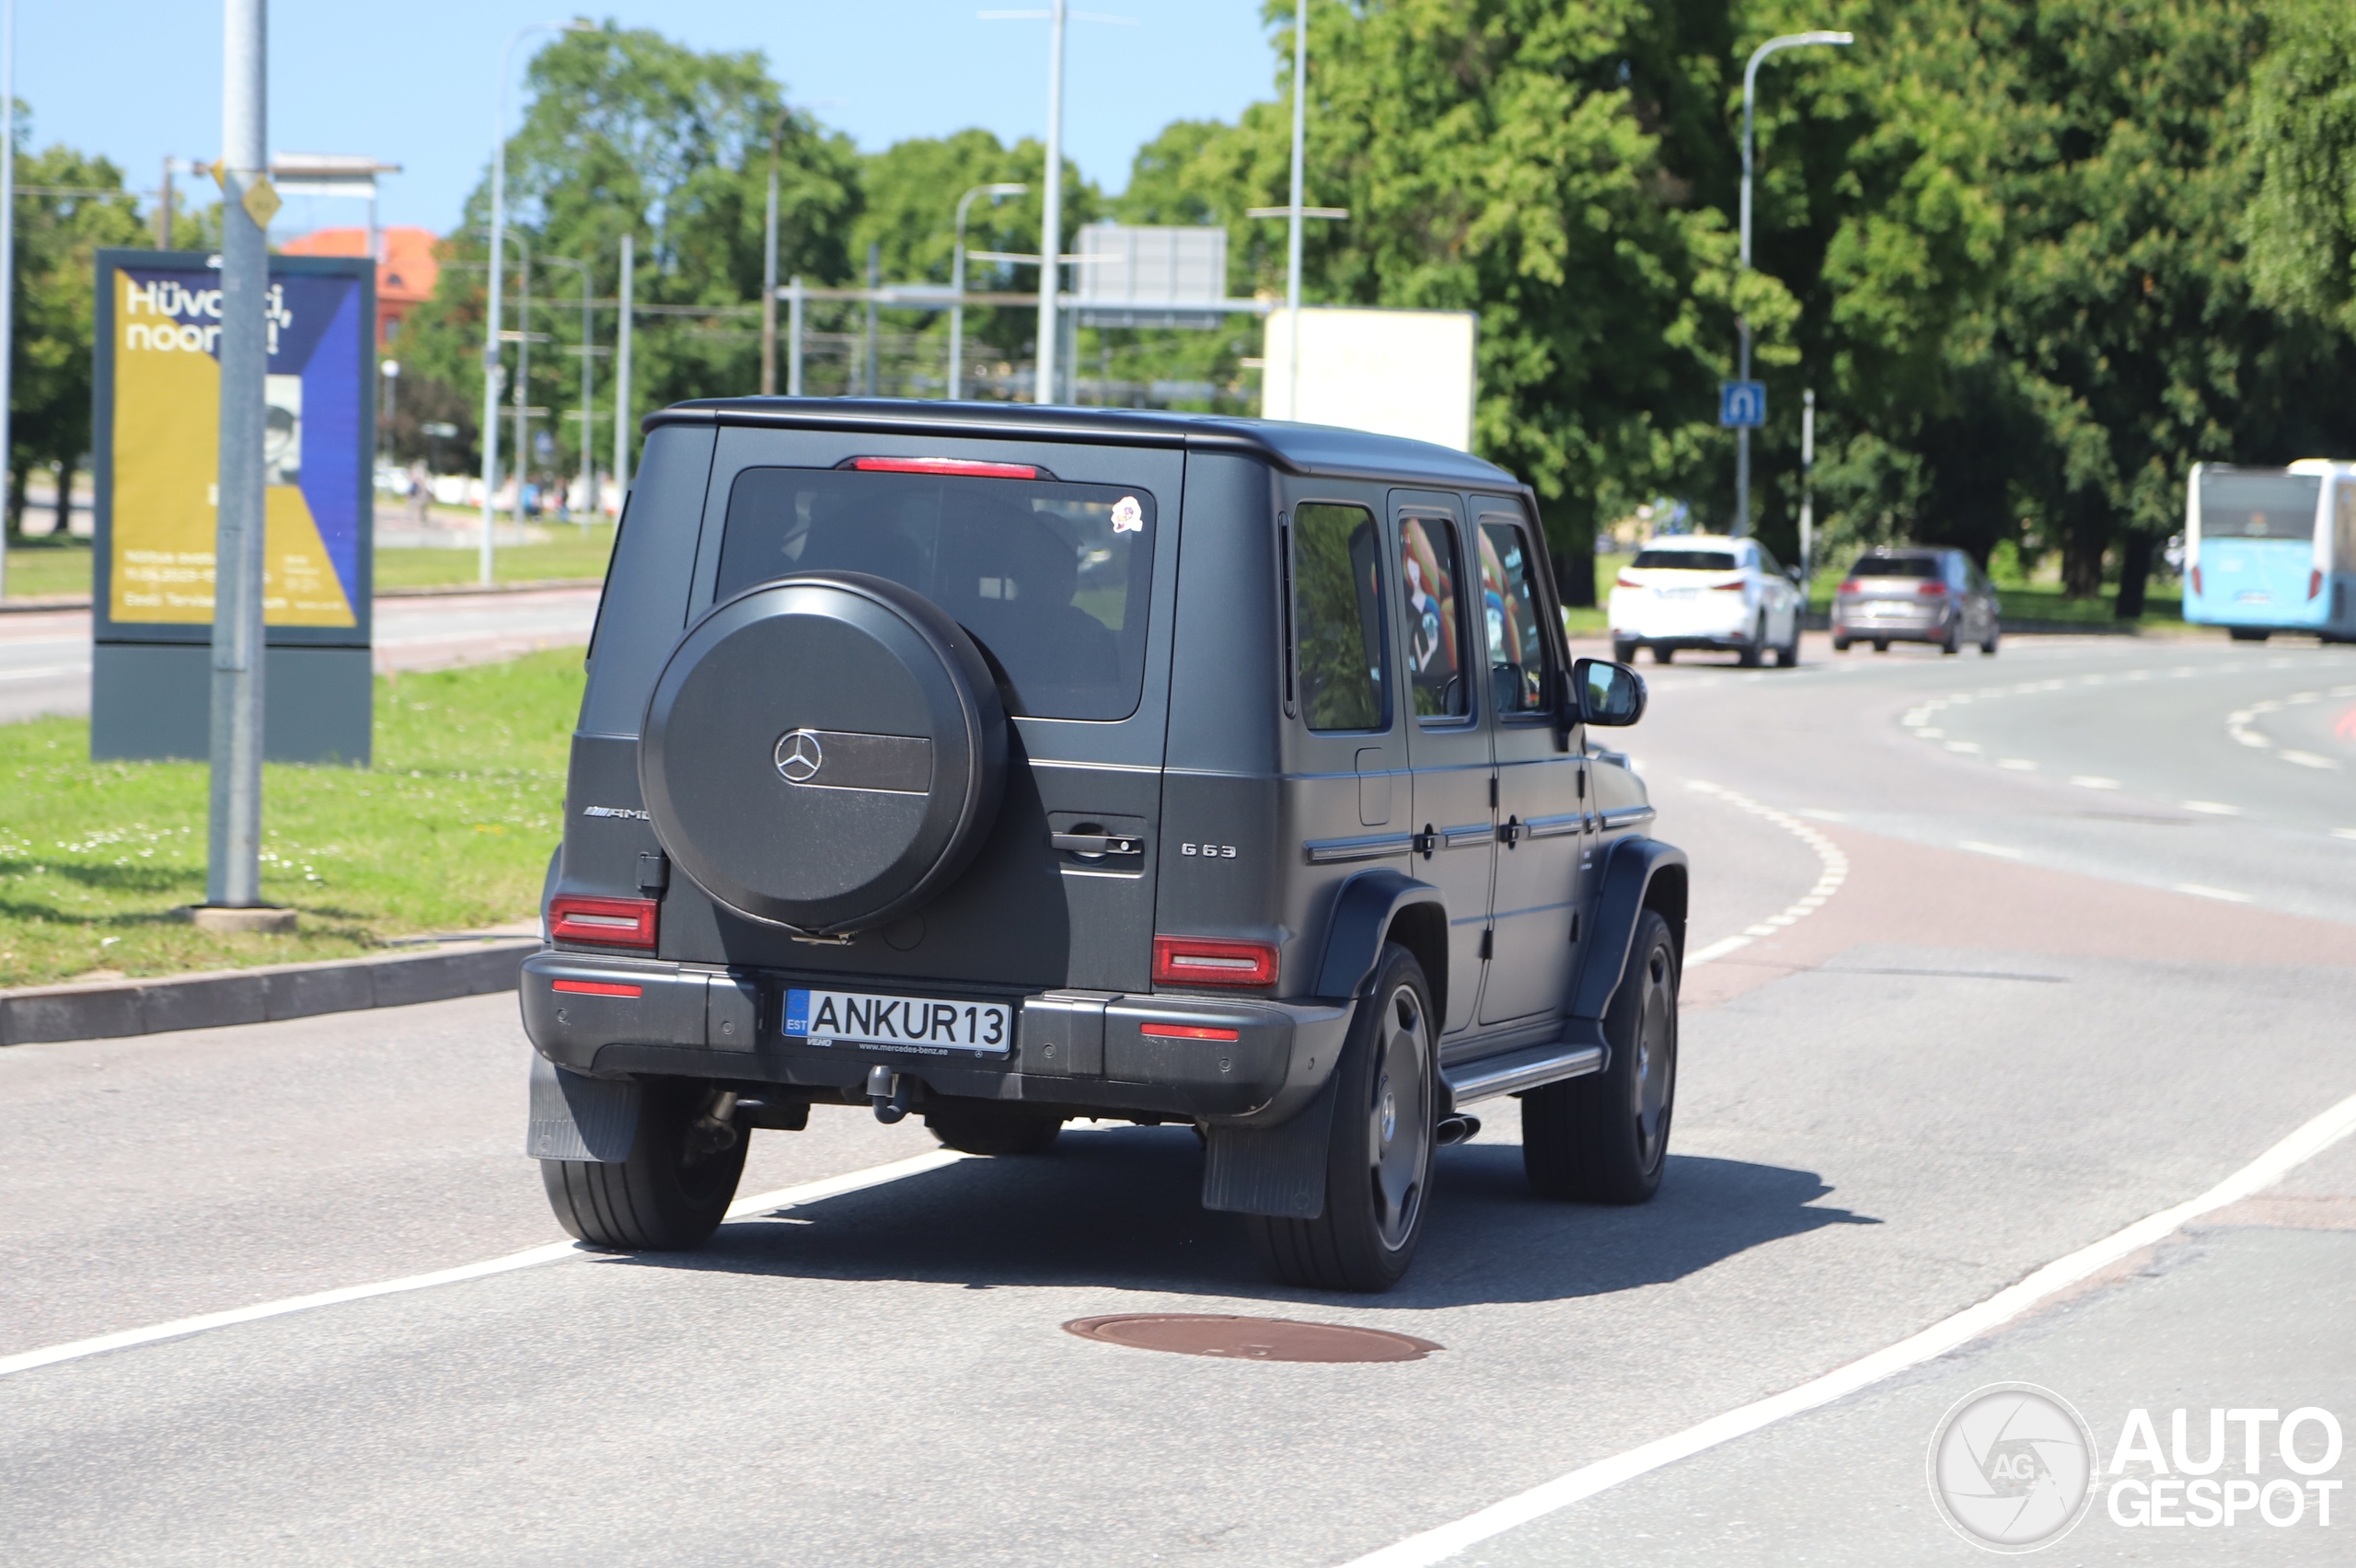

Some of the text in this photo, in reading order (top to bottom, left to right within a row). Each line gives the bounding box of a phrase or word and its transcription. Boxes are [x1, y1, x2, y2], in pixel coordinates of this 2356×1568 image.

[126, 320, 279, 355] noor!
[1202, 844, 1237, 859] 63
[787, 1019, 808, 1032] EST
[811, 996, 1004, 1045] ANKUR13
[806, 1037, 833, 1048] VEHO
[859, 1042, 949, 1056] www.mercedes-benz.ee
